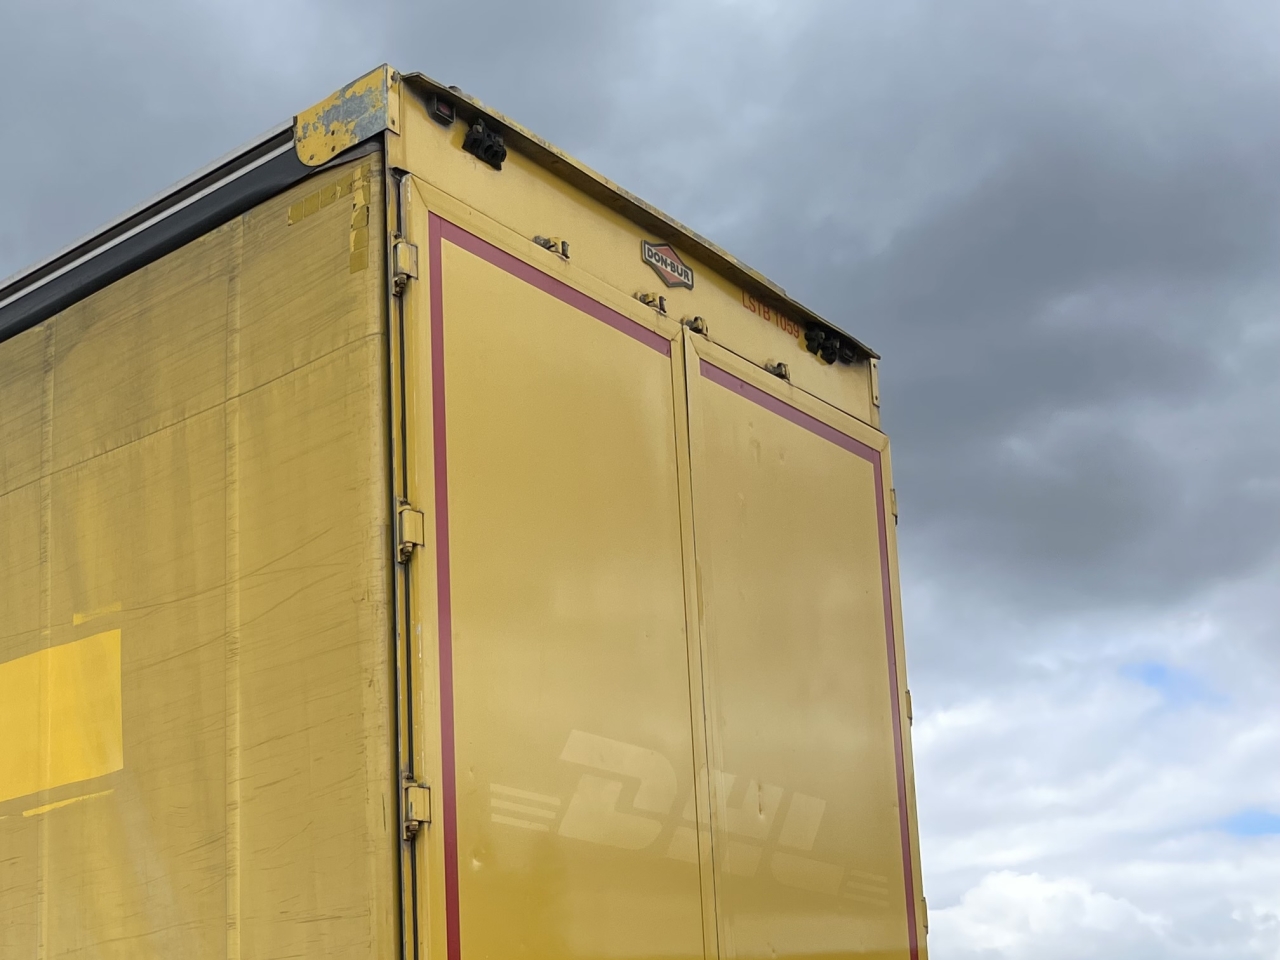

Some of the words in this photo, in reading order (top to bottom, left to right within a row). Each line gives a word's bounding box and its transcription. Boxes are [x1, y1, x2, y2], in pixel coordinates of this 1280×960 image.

[646, 246, 690, 282] DON-BUR
[741, 289, 771, 321] LSTB
[774, 312, 800, 339] 1059
